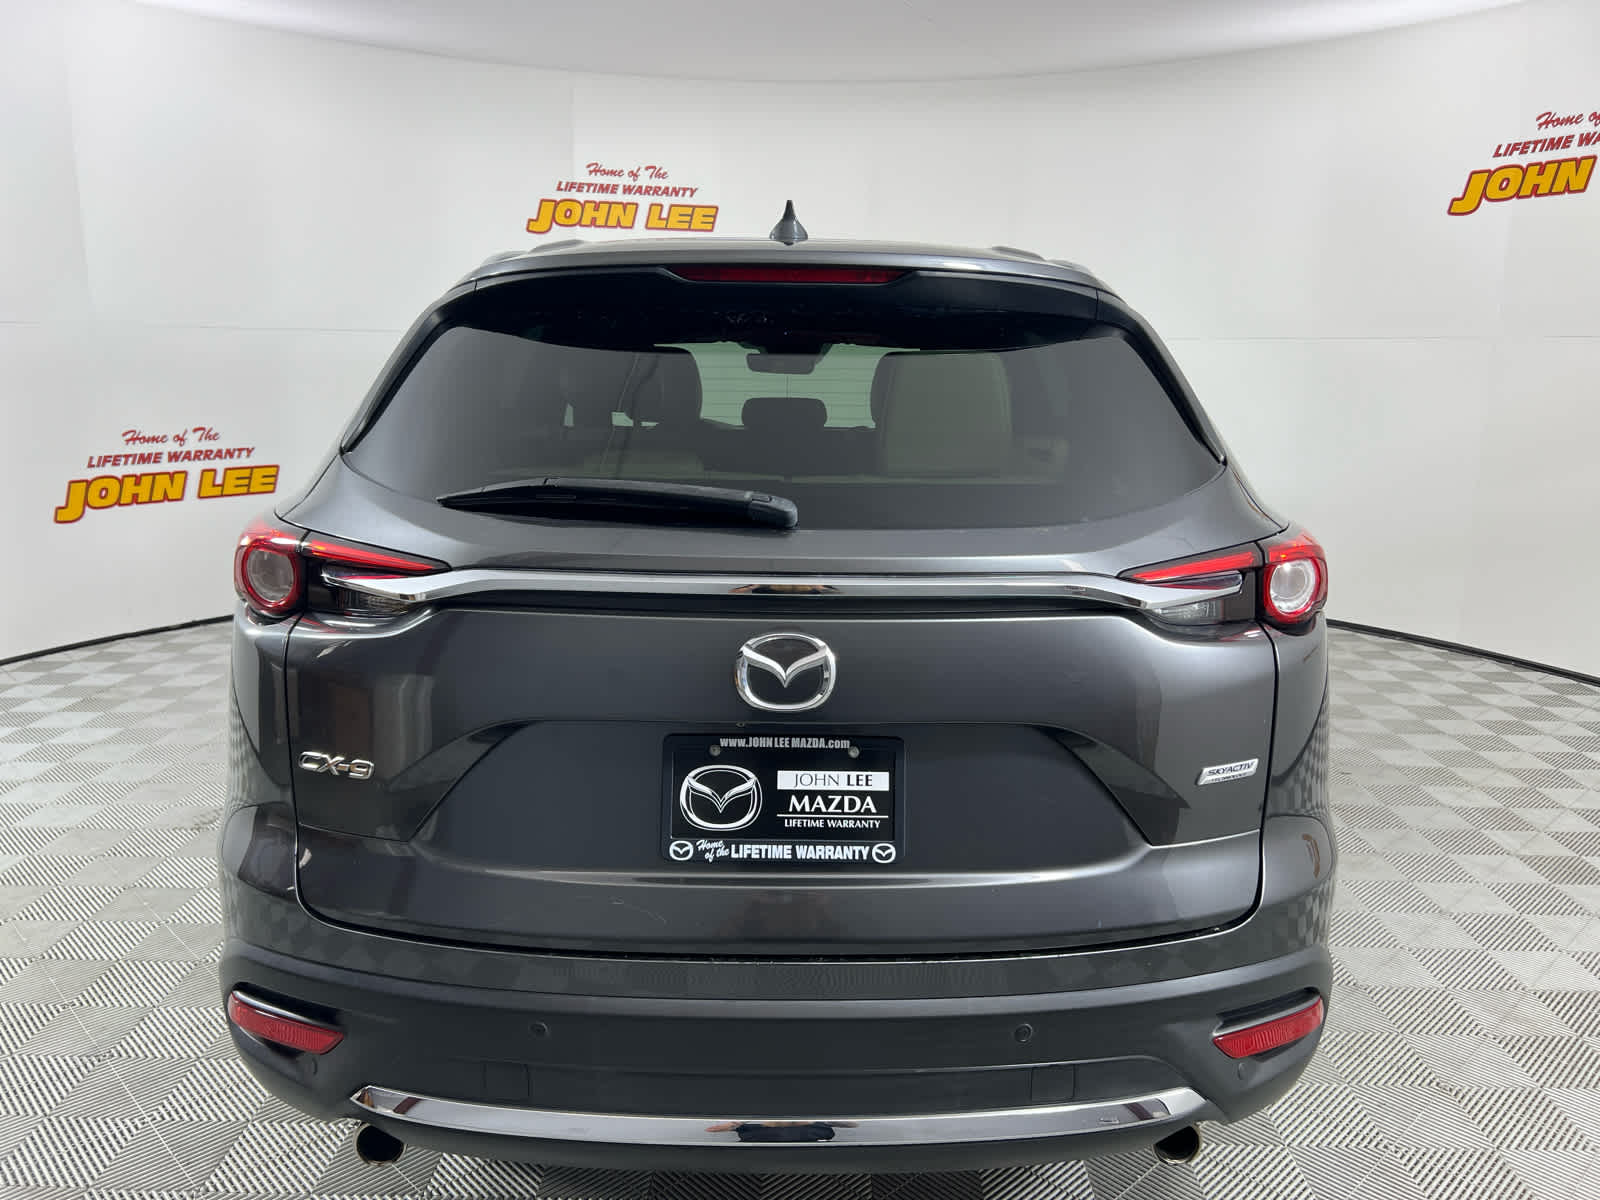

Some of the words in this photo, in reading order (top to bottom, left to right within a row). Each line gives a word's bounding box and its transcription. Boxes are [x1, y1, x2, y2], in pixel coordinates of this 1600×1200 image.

[1536, 111, 1584, 130] Home
[1492, 134, 1575, 158] LIFETIME
[586, 162, 625, 176] Home
[627, 166, 641, 182] of
[644, 165, 669, 180] The
[556, 180, 619, 195] LIFETIME
[622, 184, 698, 198] WARRANTY
[1447, 154, 1598, 216] JOHN
[526, 199, 638, 234] JOHN
[645, 203, 719, 232] LEE
[121, 429, 168, 445] Home
[172, 429, 188, 446] of
[192, 427, 220, 442] The
[87, 451, 163, 469] LIFETIME
[167, 447, 256, 464] WARRANTY
[53, 470, 188, 524] JOHN
[197, 464, 280, 499] LEE
[774, 737, 790, 748] LEE
[791, 737, 851, 749] MAZDA.com
[298, 751, 375, 780] CX-9
[1208, 761, 1255, 775] SKYACTIV
[794, 773, 840, 788] JOHN
[846, 774, 873, 787] LEE
[788, 794, 878, 814] MAZDA
[784, 818, 825, 829] LIFETIME
[826, 819, 881, 829] WARRANTY
[696, 839, 724, 852] Home
[704, 849, 715, 863] of
[716, 846, 730, 858] the
[731, 844, 793, 859] LIFETIME
[795, 845, 870, 860] WARRANTY
